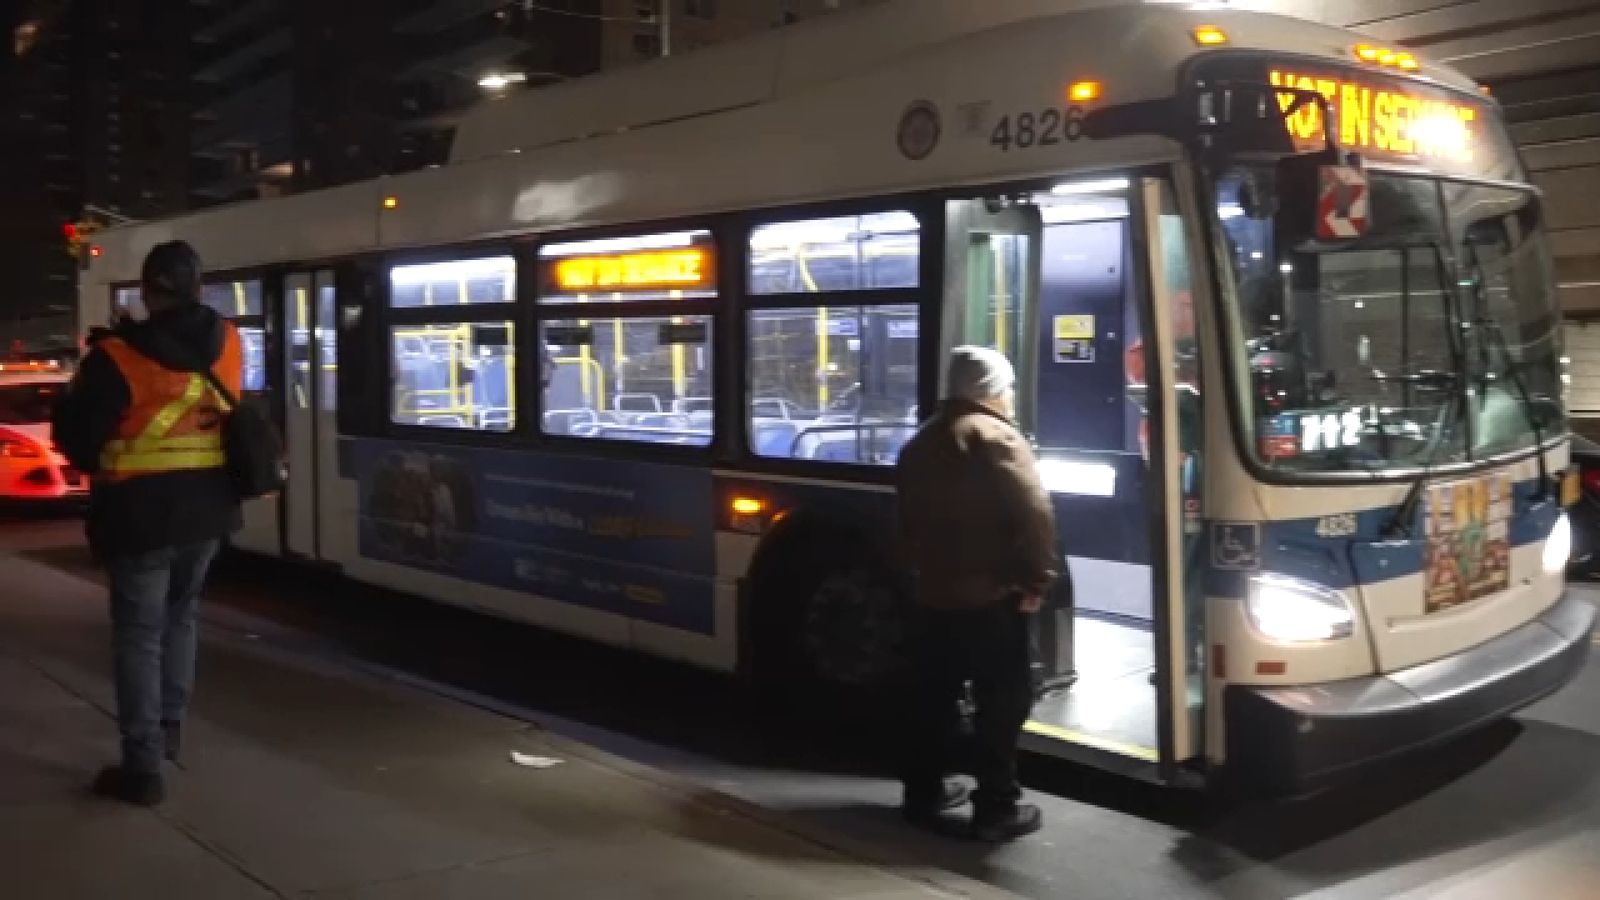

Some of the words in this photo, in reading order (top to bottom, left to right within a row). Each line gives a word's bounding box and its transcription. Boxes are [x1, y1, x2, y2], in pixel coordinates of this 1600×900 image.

[990, 105, 1084, 152] 4826
[1340, 84, 1370, 146] IN
[1374, 92, 1476, 162] SERE
